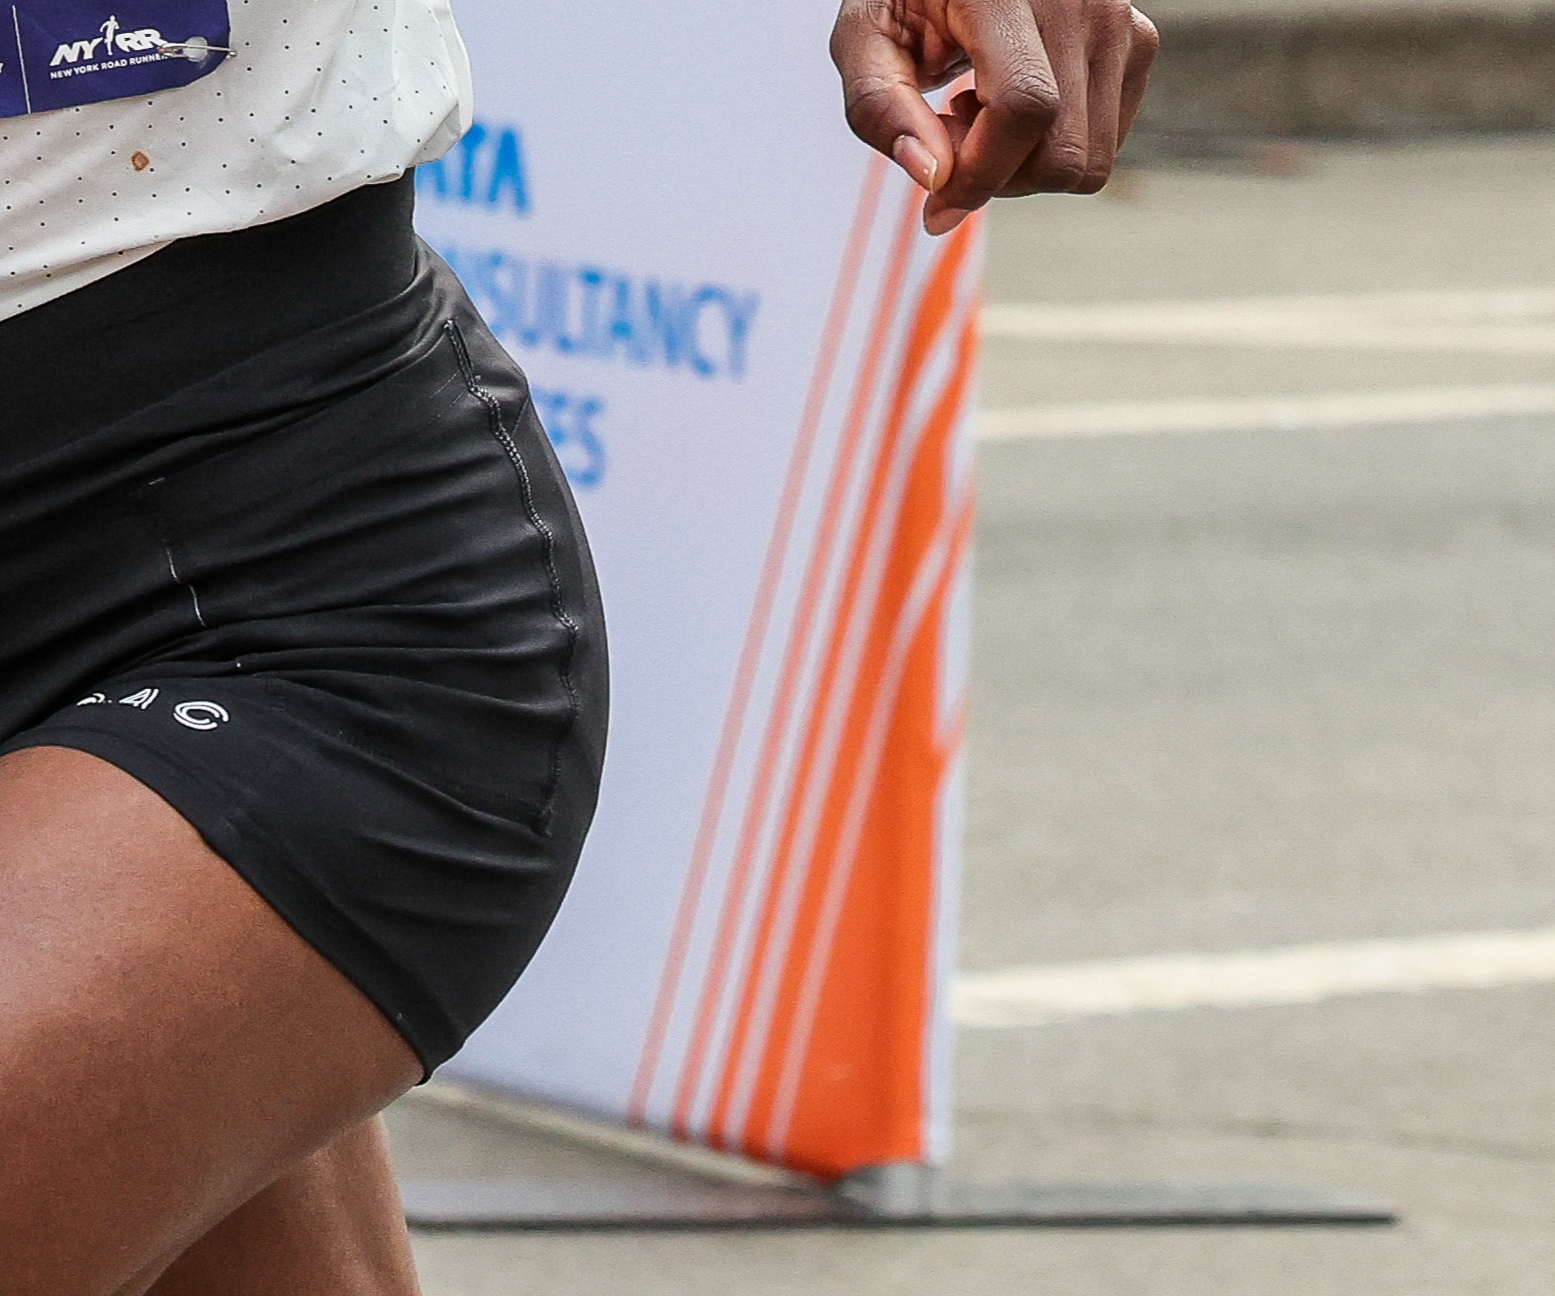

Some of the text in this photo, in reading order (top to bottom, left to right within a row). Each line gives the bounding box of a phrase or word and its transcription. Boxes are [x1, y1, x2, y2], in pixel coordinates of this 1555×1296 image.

[50, 52, 169, 80] NEW YORK ROAD RUNNE
